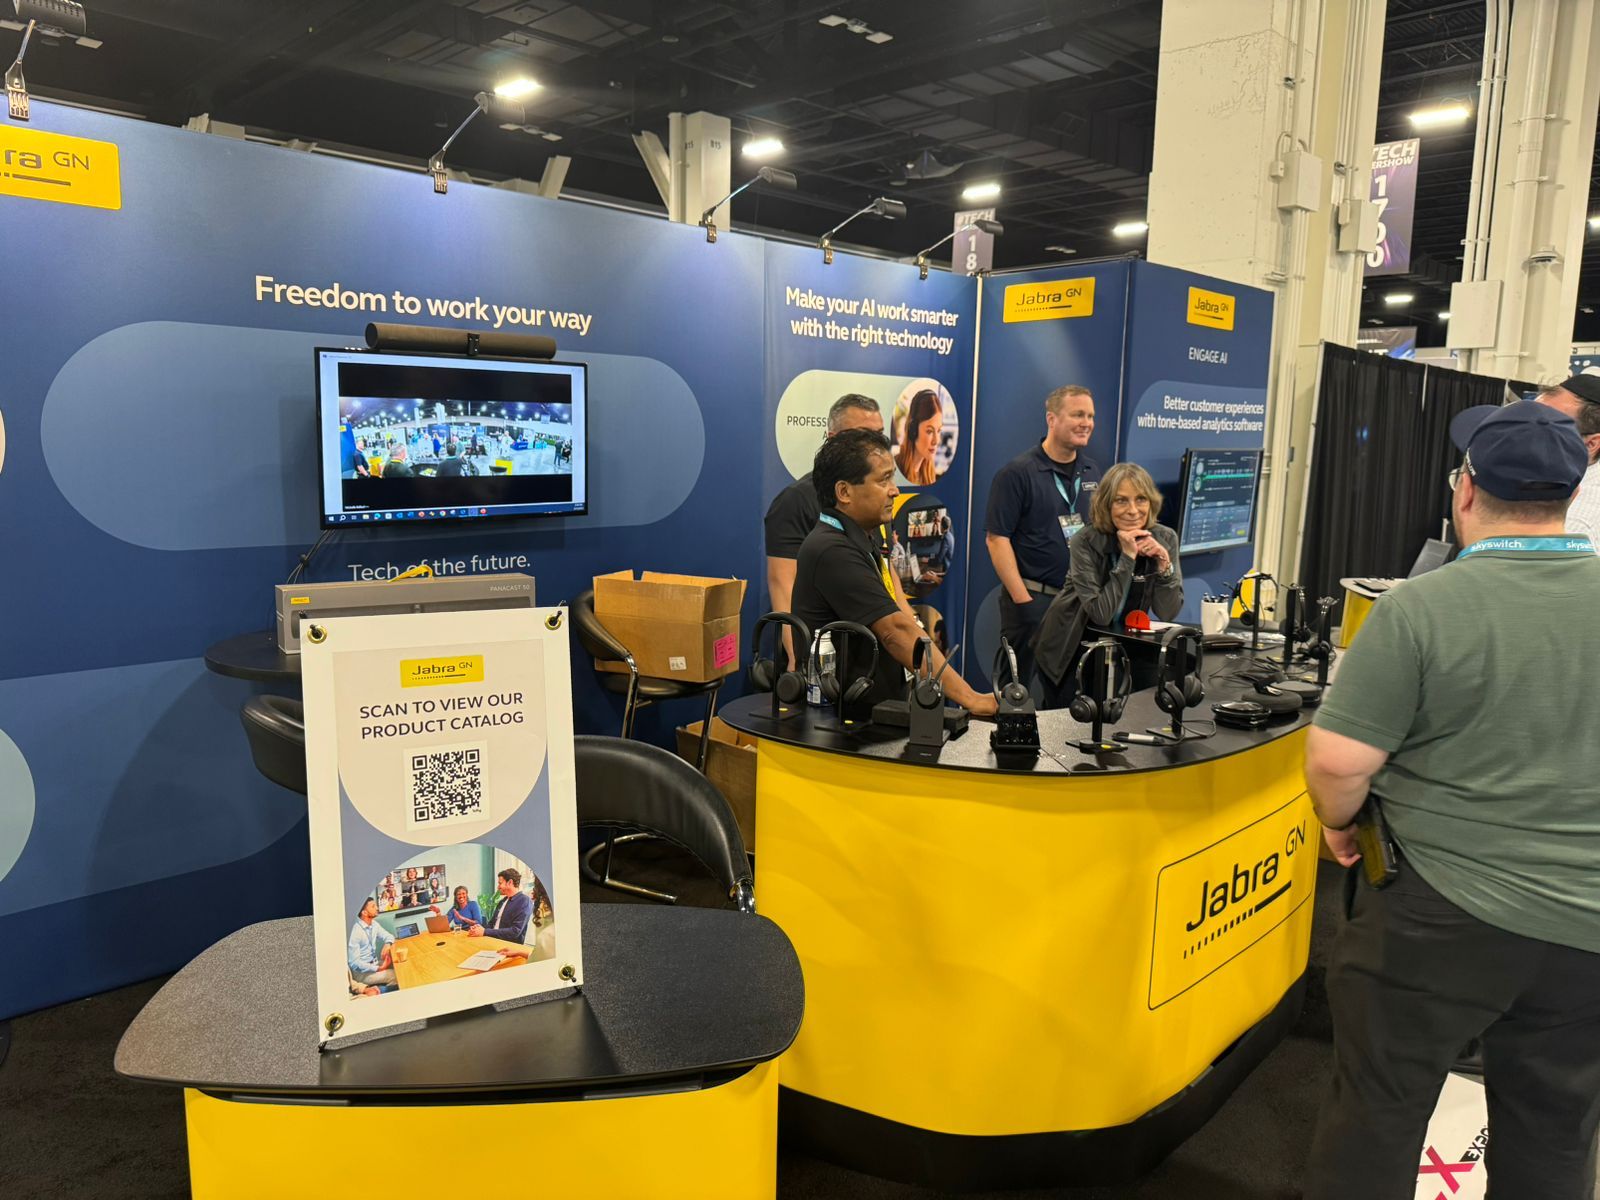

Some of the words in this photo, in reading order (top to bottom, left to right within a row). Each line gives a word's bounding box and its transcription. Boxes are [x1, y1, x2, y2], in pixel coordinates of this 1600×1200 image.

[53, 151, 89, 170] GN
[255, 275, 387, 312] Freedom
[392, 291, 422, 315] to
[426, 297, 490, 321] work
[493, 304, 545, 329] your
[549, 310, 593, 336] way
[786, 286, 825, 311] Make
[827, 297, 860, 317] your
[861, 299, 875, 317] AI
[877, 302, 910, 321] work
[911, 308, 959, 327] smarter
[1016, 292, 1062, 306] Jabra
[1065, 287, 1082, 298] GN
[1194, 297, 1219, 314] Jabra
[791, 317, 823, 338] with
[826, 321, 850, 341] the
[851, 324, 884, 348] right
[885, 329, 954, 356] technology
[1188, 347, 1219, 364] ENGAGE
[1219, 351, 1228, 365] AI
[1163, 395, 1189, 411] Better
[1189, 399, 1225, 414] customer
[1225, 401, 1265, 417] experiences
[787, 415, 828, 428] PROFESS
[1137, 412, 1156, 428] with
[1157, 414, 1201, 430] tone-based
[1201, 417, 1233, 434] analytics
[1233, 418, 1263, 431] software
[348, 561, 399, 582] Tech
[432, 557, 467, 576] the
[470, 554, 531, 572] future.
[412, 664, 456, 676] Jabra
[458, 661, 473, 670] GN
[359, 702, 409, 719] SCAN
[411, 700, 437, 714] TO
[439, 695, 484, 712] VIEW
[486, 692, 524, 708] OUR
[361, 718, 447, 740] PRODUCT
[449, 711, 525, 731] CATALOG
[1186, 852, 1279, 933] Jabra
[1285, 819, 1306, 857] GN
